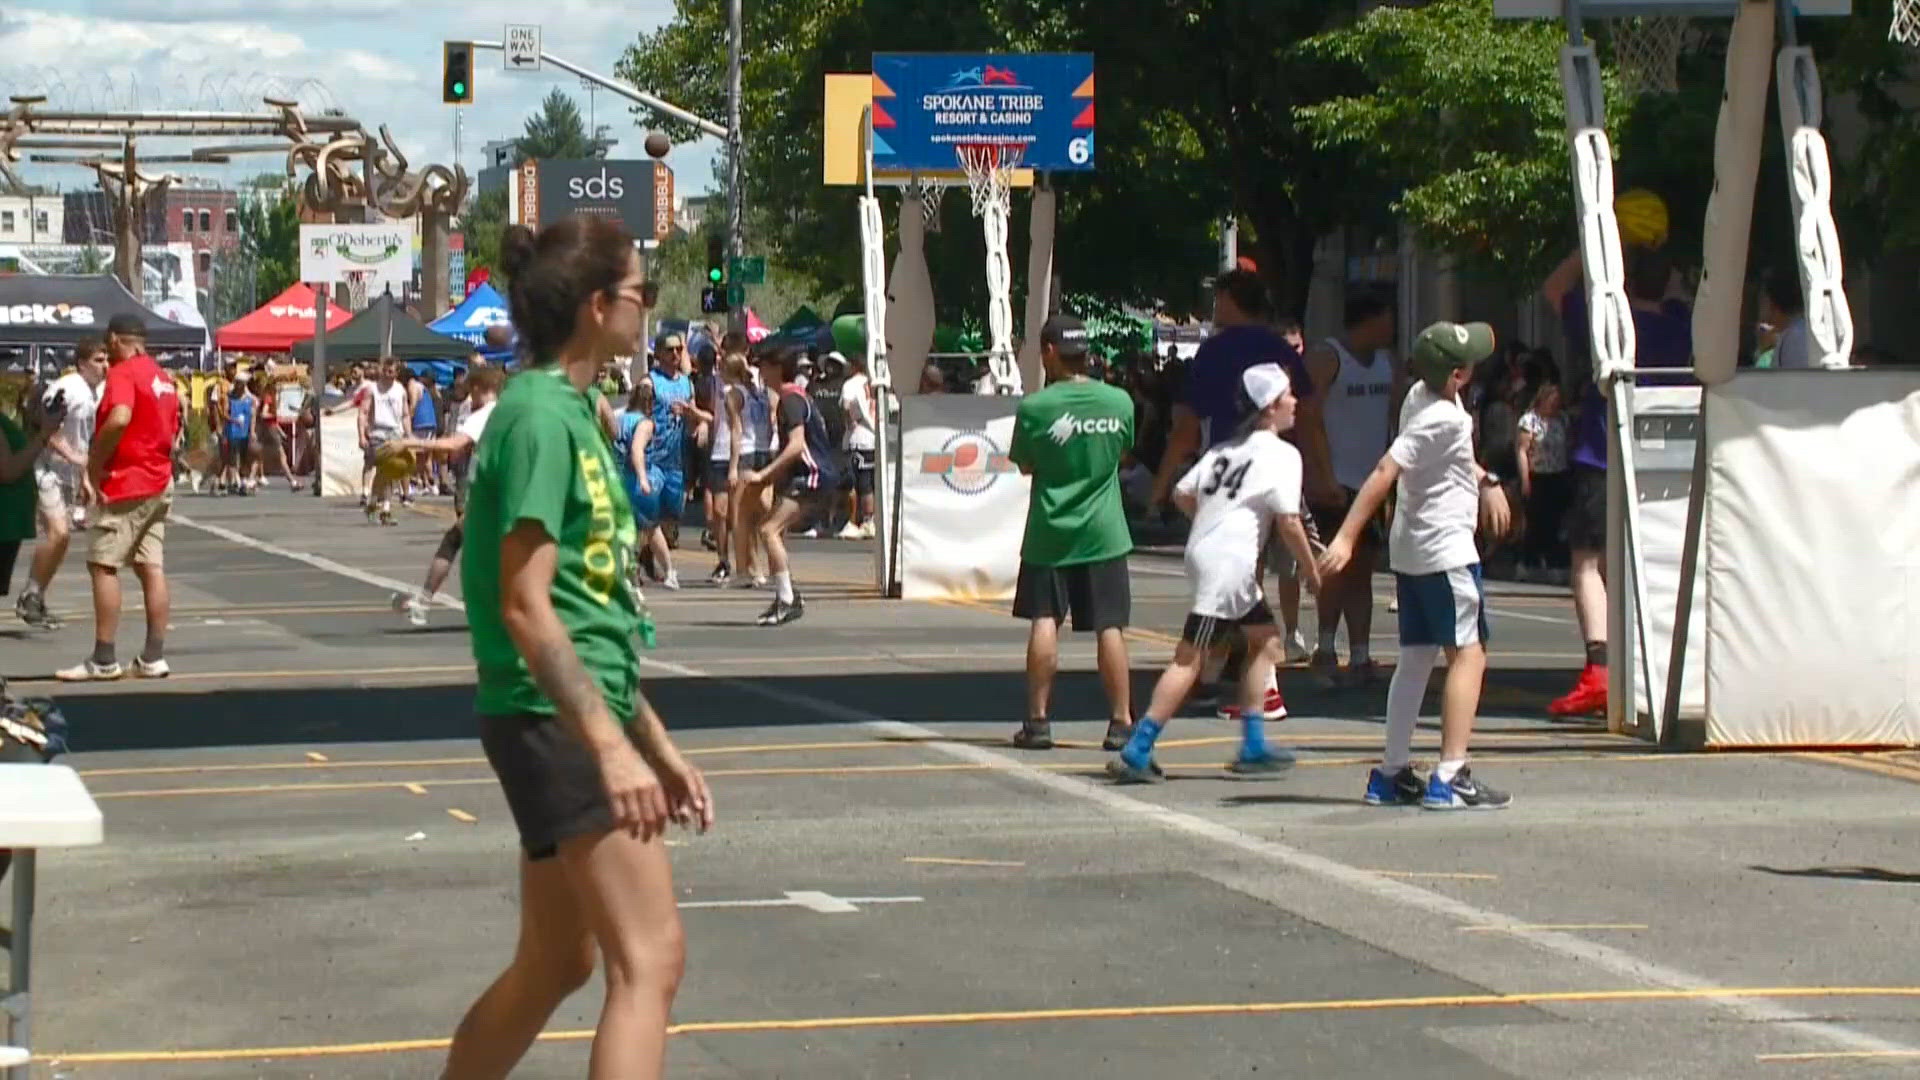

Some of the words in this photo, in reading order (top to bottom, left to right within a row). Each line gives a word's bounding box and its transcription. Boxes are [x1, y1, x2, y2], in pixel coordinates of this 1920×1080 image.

[511, 29, 535, 40] ONE
[511, 41, 535, 52] WAY
[923, 95, 995, 110] SPOKANE
[999, 95, 1043, 110] TRIBE
[935, 112, 976, 124] RESORT
[980, 112, 987, 124] &
[991, 112, 1031, 124] CASINO
[931, 134, 1036, 145] spokanetribecasino.com
[1068, 137, 1089, 164] 6
[569, 167, 624, 199] sds
[656, 165, 669, 233] DRIBBLE
[1074, 417, 1120, 434] ICCU
[1204, 456, 1253, 500] 34
